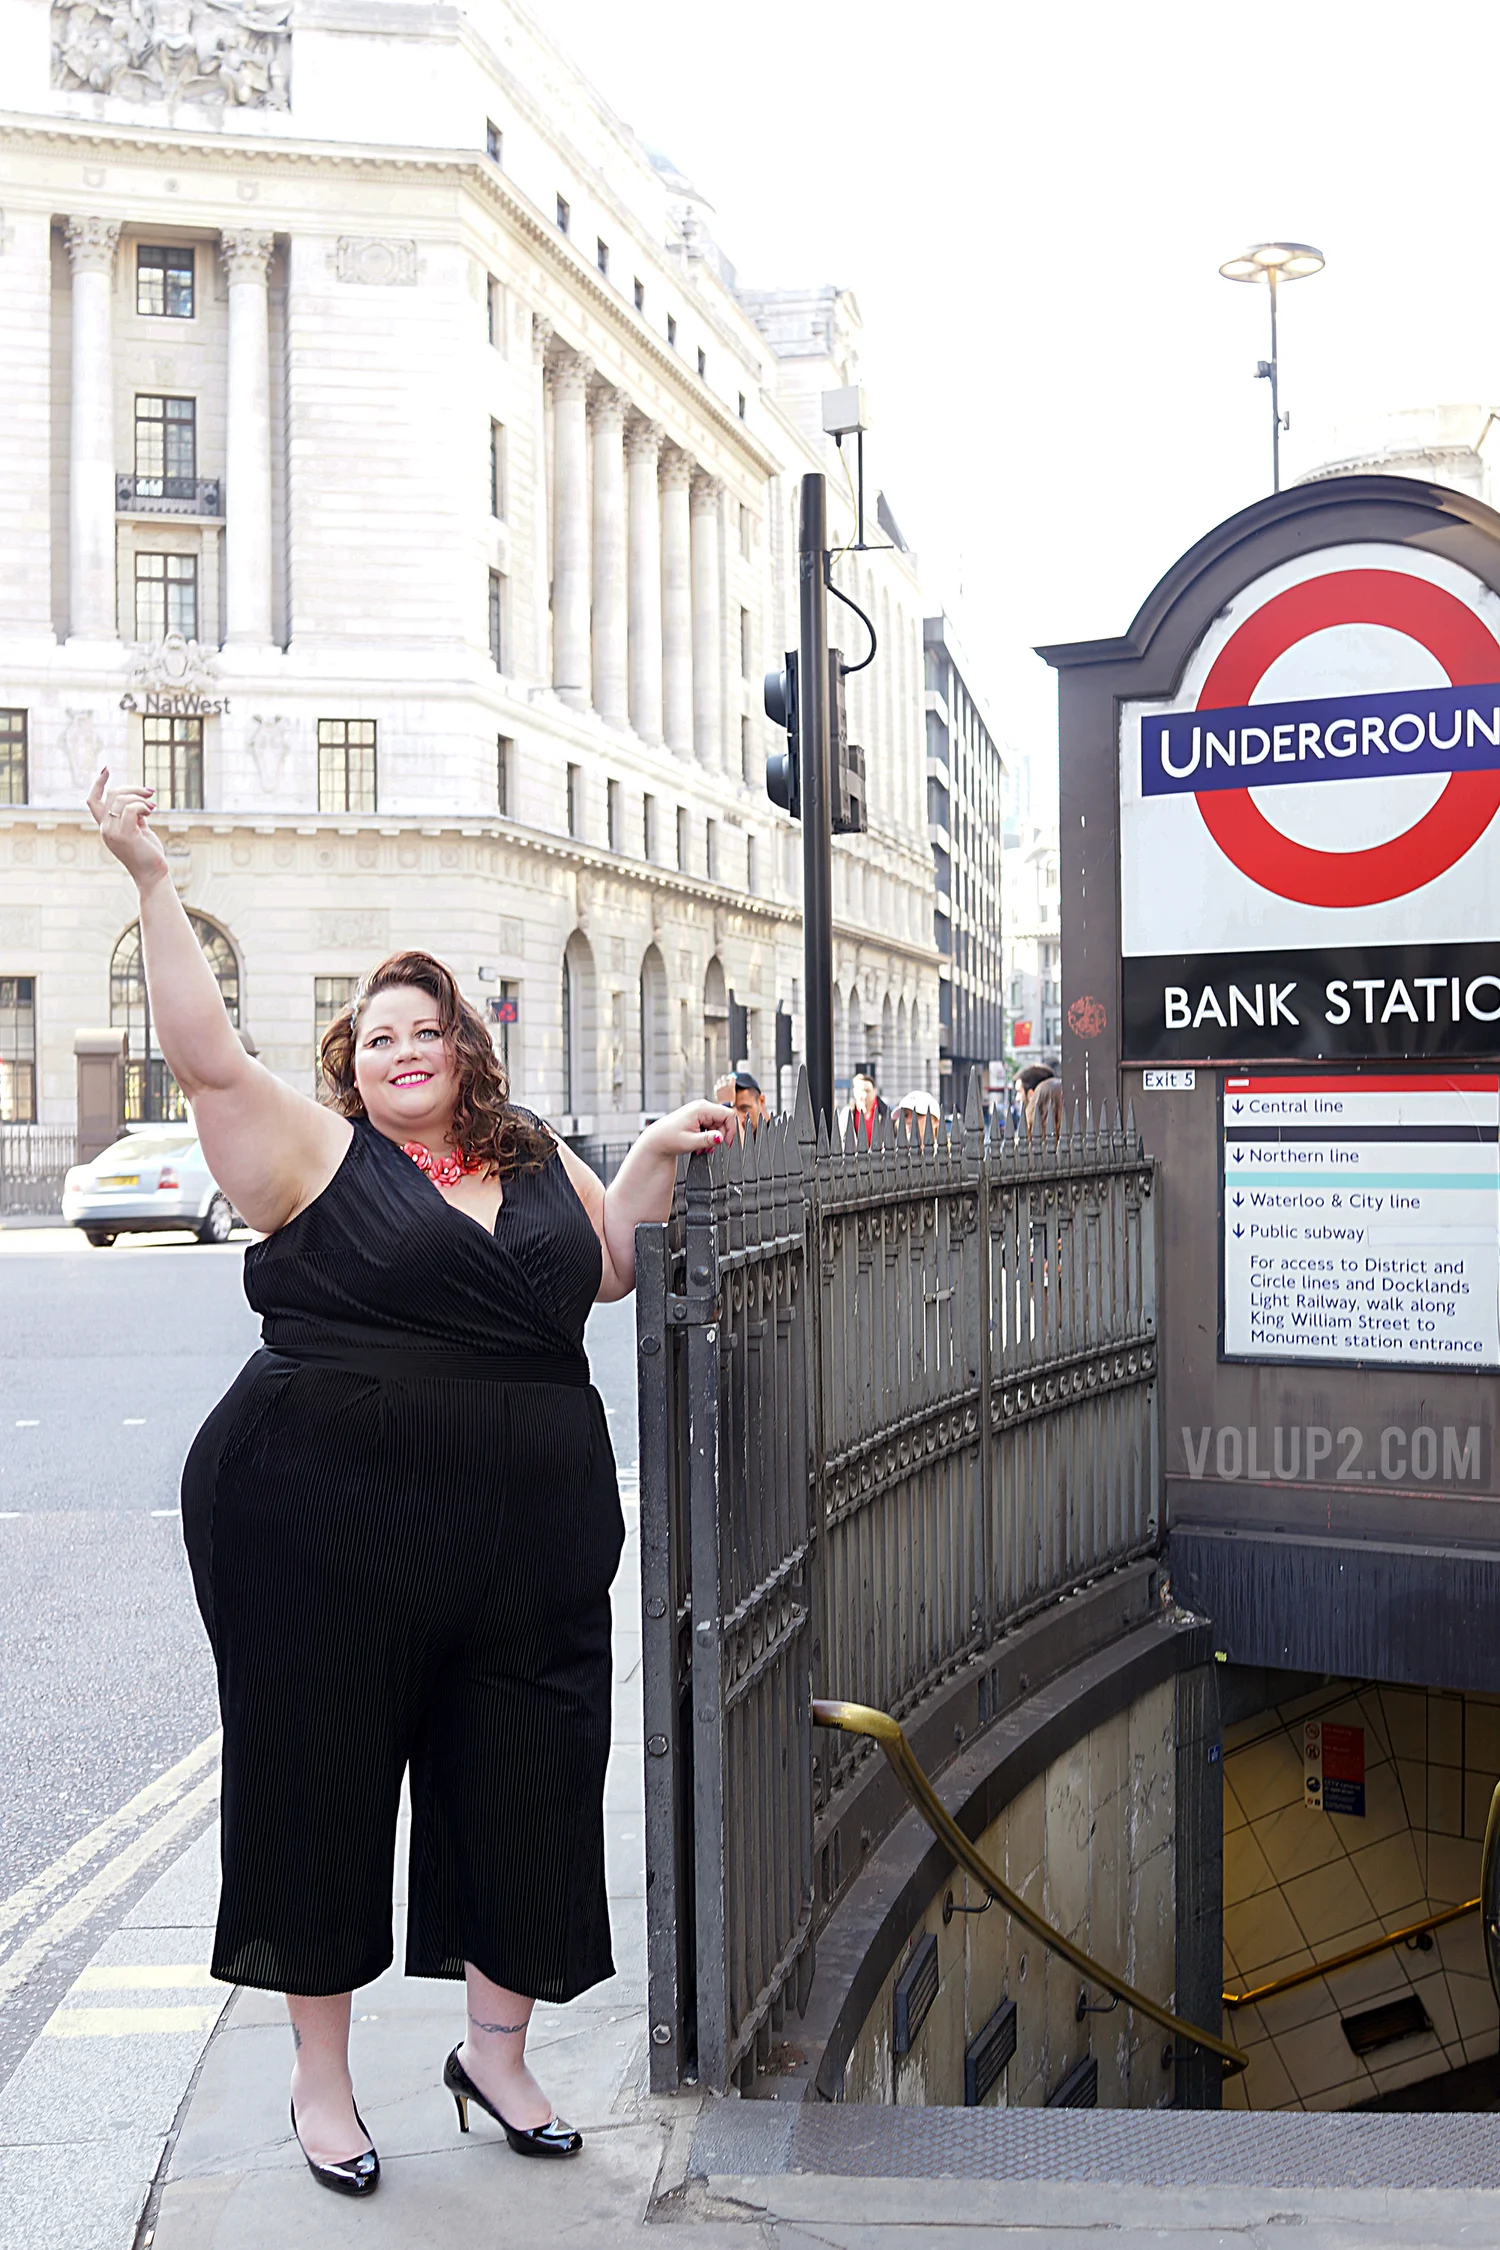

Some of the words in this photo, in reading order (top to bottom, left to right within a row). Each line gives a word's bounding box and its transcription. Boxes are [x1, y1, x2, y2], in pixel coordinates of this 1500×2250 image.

[146, 693, 231, 714] NatWest
[1161, 707, 1500, 779] UNDERGROUN
[1165, 983, 1299, 1028] BANK
[1325, 976, 1500, 1024] STATIO
[1145, 1073, 1177, 1087] Exit
[1184, 1073, 1193, 1087] 5
[1250, 1100, 1307, 1112] Central
[1315, 1100, 1342, 1112] line
[1251, 1149, 1323, 1162] Northern
[1331, 1149, 1358, 1162] line
[1251, 1193, 1324, 1206] Waterloo
[1332, 1195, 1342, 1207] &
[1350, 1195, 1383, 1211] City
[1391, 1195, 1419, 1208] line
[1251, 1225, 1298, 1237] Public
[1305, 1226, 1364, 1242] subway
[1251, 1256, 1273, 1268] For
[1281, 1260, 1333, 1270] access
[1342, 1259, 1358, 1271] to
[1366, 1259, 1427, 1272] District
[1434, 1261, 1463, 1273] and
[1251, 1274, 1295, 1288] Circle
[1303, 1276, 1339, 1289] lines
[1347, 1278, 1374, 1290] and
[1383, 1278, 1469, 1293] Docklands
[1252, 1293, 1287, 1309] Light
[1297, 1295, 1359, 1312] Railway,
[1367, 1297, 1403, 1310] walk
[1411, 1298, 1455, 1315] along
[1252, 1312, 1284, 1328] King
[1292, 1313, 1351, 1328] William
[1359, 1315, 1409, 1330] Street
[1418, 1319, 1435, 1331] to
[1252, 1330, 1337, 1345] Monument
[1345, 1335, 1402, 1348] station
[1410, 1338, 1482, 1351] entrance
